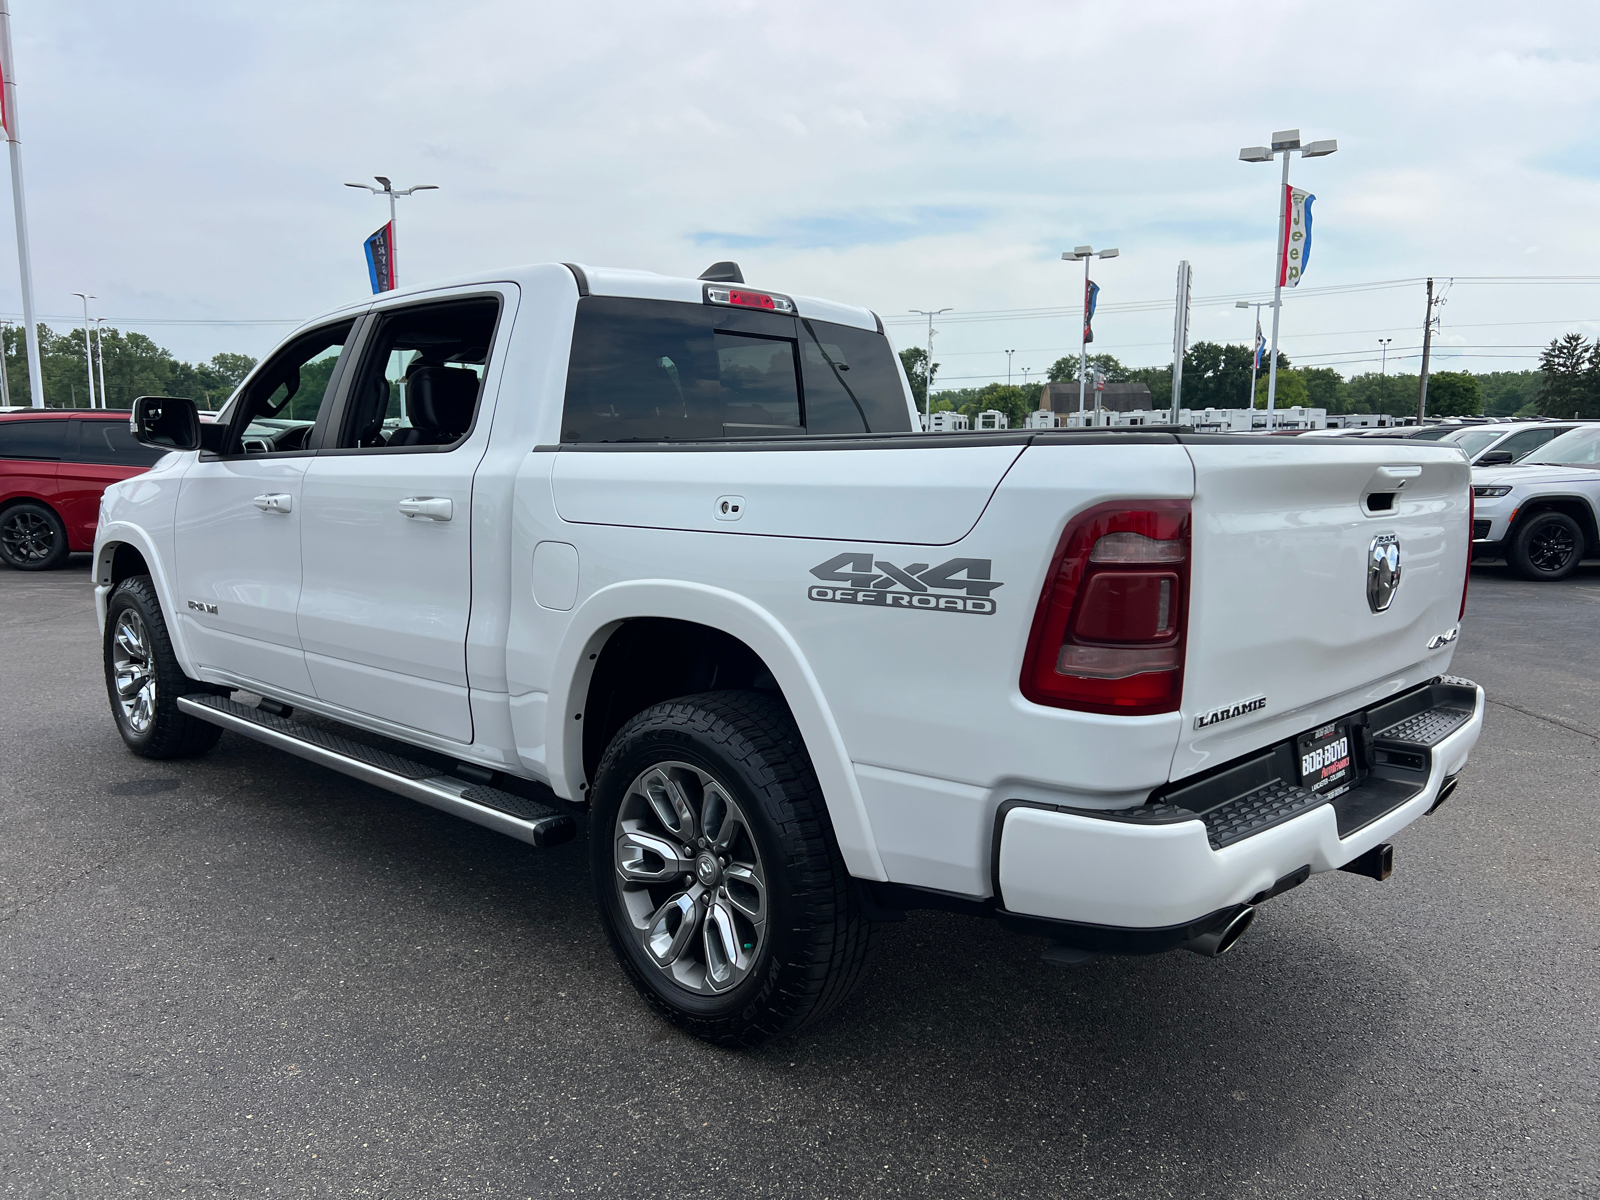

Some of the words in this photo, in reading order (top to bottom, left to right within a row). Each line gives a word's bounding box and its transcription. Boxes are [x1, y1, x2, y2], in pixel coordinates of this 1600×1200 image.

[1288, 209, 1303, 281] Jeep
[1378, 534, 1396, 543] RAM
[187, 599, 219, 615] RAM
[811, 587, 878, 603] OFF
[886, 593, 992, 613] ROAD
[1195, 696, 1266, 729] LARAMIE
